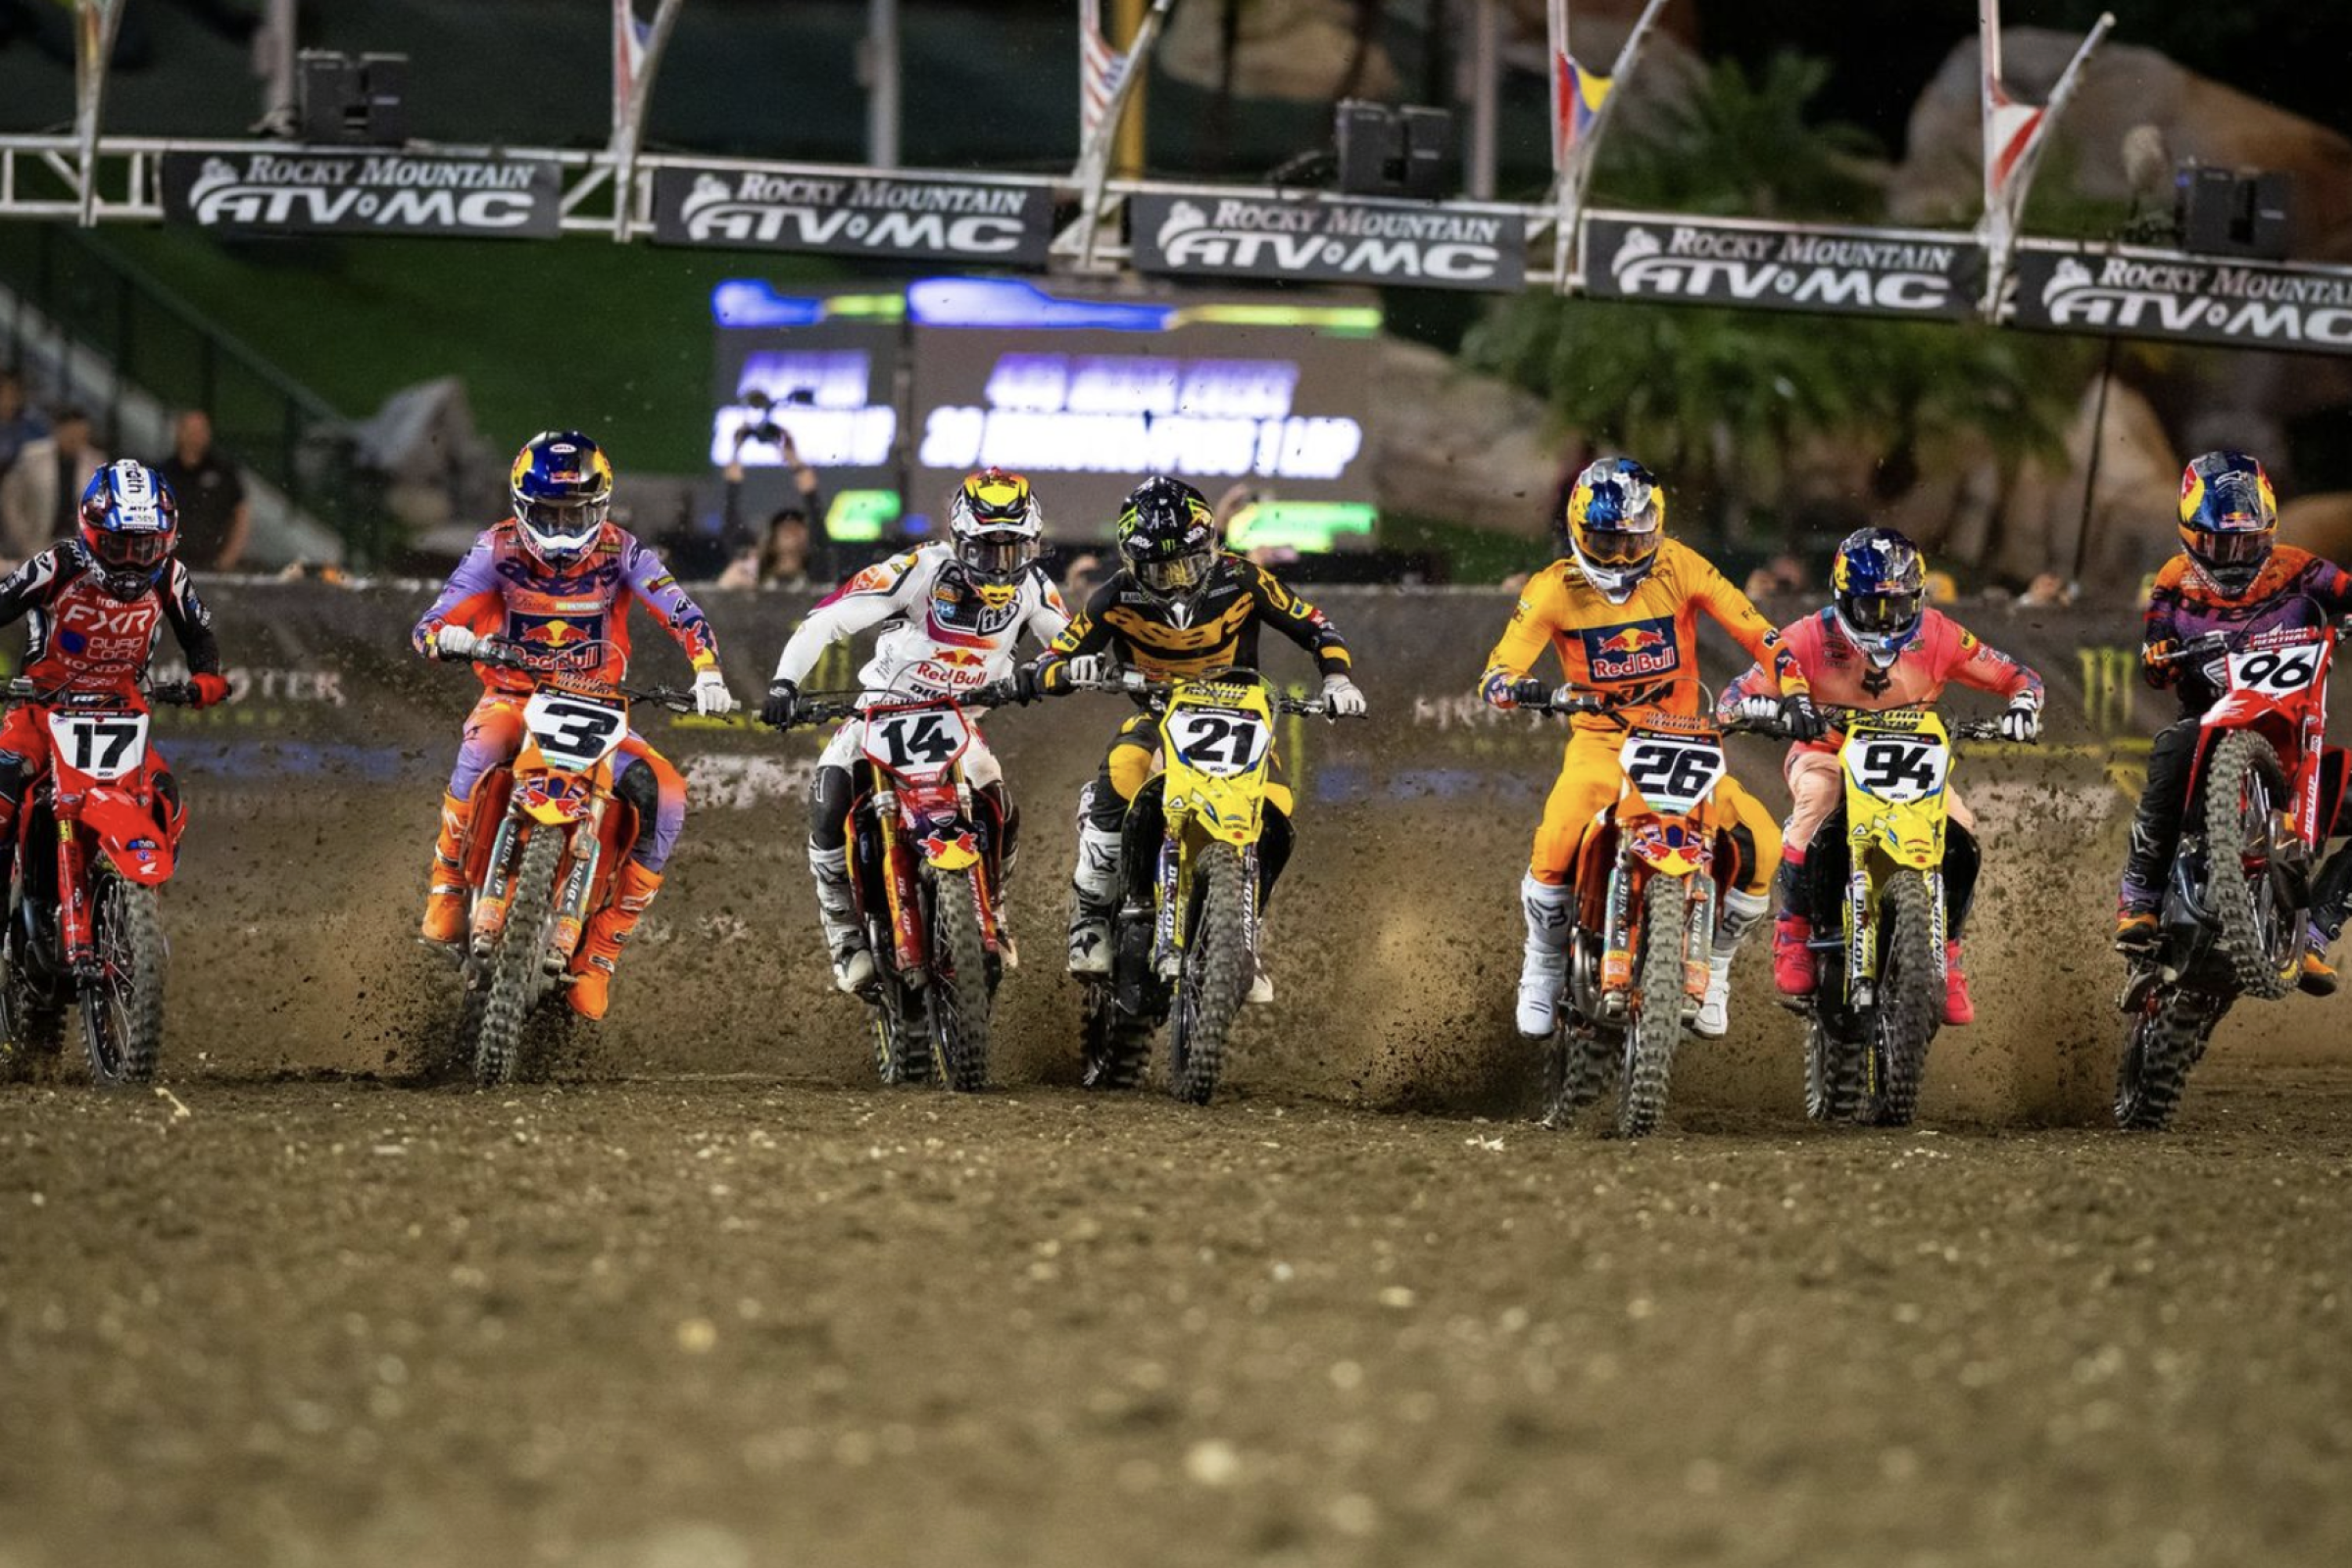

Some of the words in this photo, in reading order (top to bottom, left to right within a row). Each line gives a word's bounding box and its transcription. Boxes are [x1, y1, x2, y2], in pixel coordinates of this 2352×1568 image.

[246, 155, 354, 185] ROCKY
[357, 157, 535, 189] MOUNTAIN
[737, 172, 847, 205] ROCKY
[849, 179, 1027, 215] MOUNTAIN
[1213, 199, 1322, 232] ROCKY
[1325, 207, 1501, 242] MOUNTAIN
[1668, 226, 1776, 259] ROCKY
[1778, 235, 1955, 270] MOUNTAIN
[2098, 257, 2206, 292] ROCKY
[64, 604, 151, 634] FXR
[86, 647, 138, 661] LOCK
[89, 636, 144, 649] QUAD
[1592, 654, 1637, 678] Red
[1637, 646, 1675, 673] Bull
[916, 662, 955, 683] Red
[953, 669, 988, 686] Bull
[2239, 652, 2313, 689] 96
[73, 723, 138, 769] 17
[534, 703, 619, 760] 3
[880, 714, 958, 767] 14
[1182, 717, 1257, 766] 21
[1629, 745, 1721, 800] 26
[1863, 744, 1936, 790] 94
[1854, 899, 1866, 973] DUNLOP
